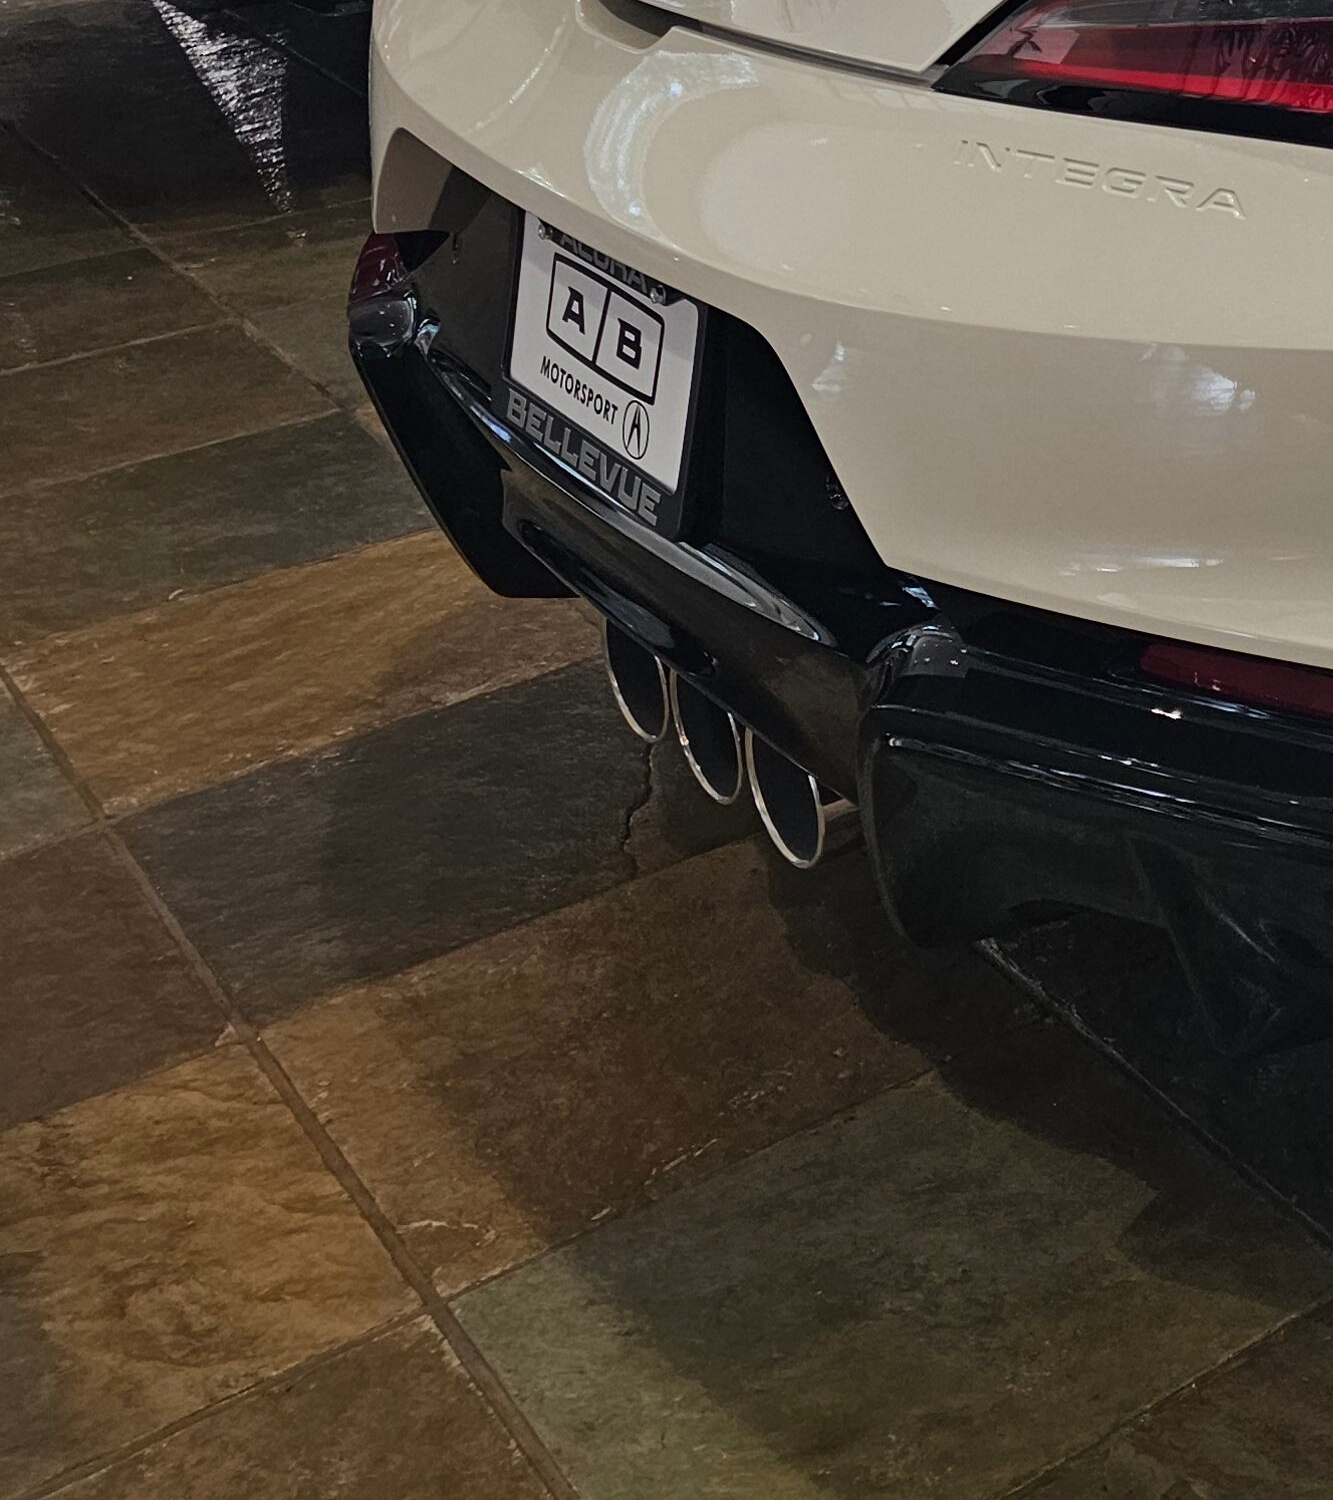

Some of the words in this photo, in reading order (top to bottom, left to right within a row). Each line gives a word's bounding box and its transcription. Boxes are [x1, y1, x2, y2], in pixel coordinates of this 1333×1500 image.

[954, 139, 1246, 220] INTEGRA
[562, 285, 586, 335] A
[616, 317, 643, 370] B
[540, 356, 619, 425] MOTORSPORT
[506, 388, 661, 526] BELLEVUE
